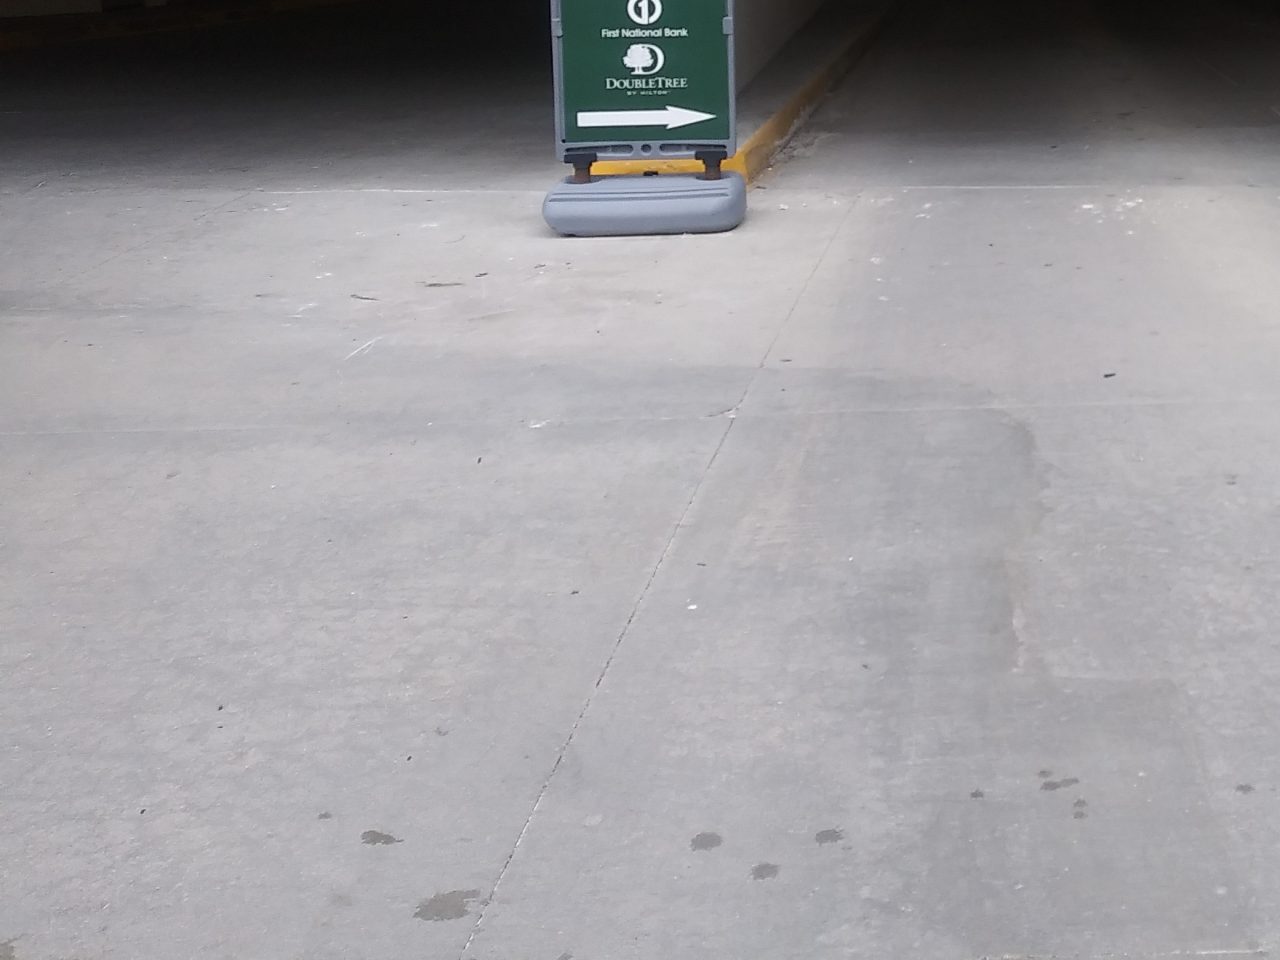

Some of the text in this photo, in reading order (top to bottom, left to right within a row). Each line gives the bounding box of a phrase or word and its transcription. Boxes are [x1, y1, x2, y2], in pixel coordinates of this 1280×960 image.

[601, 27, 689, 38] First National Bank
